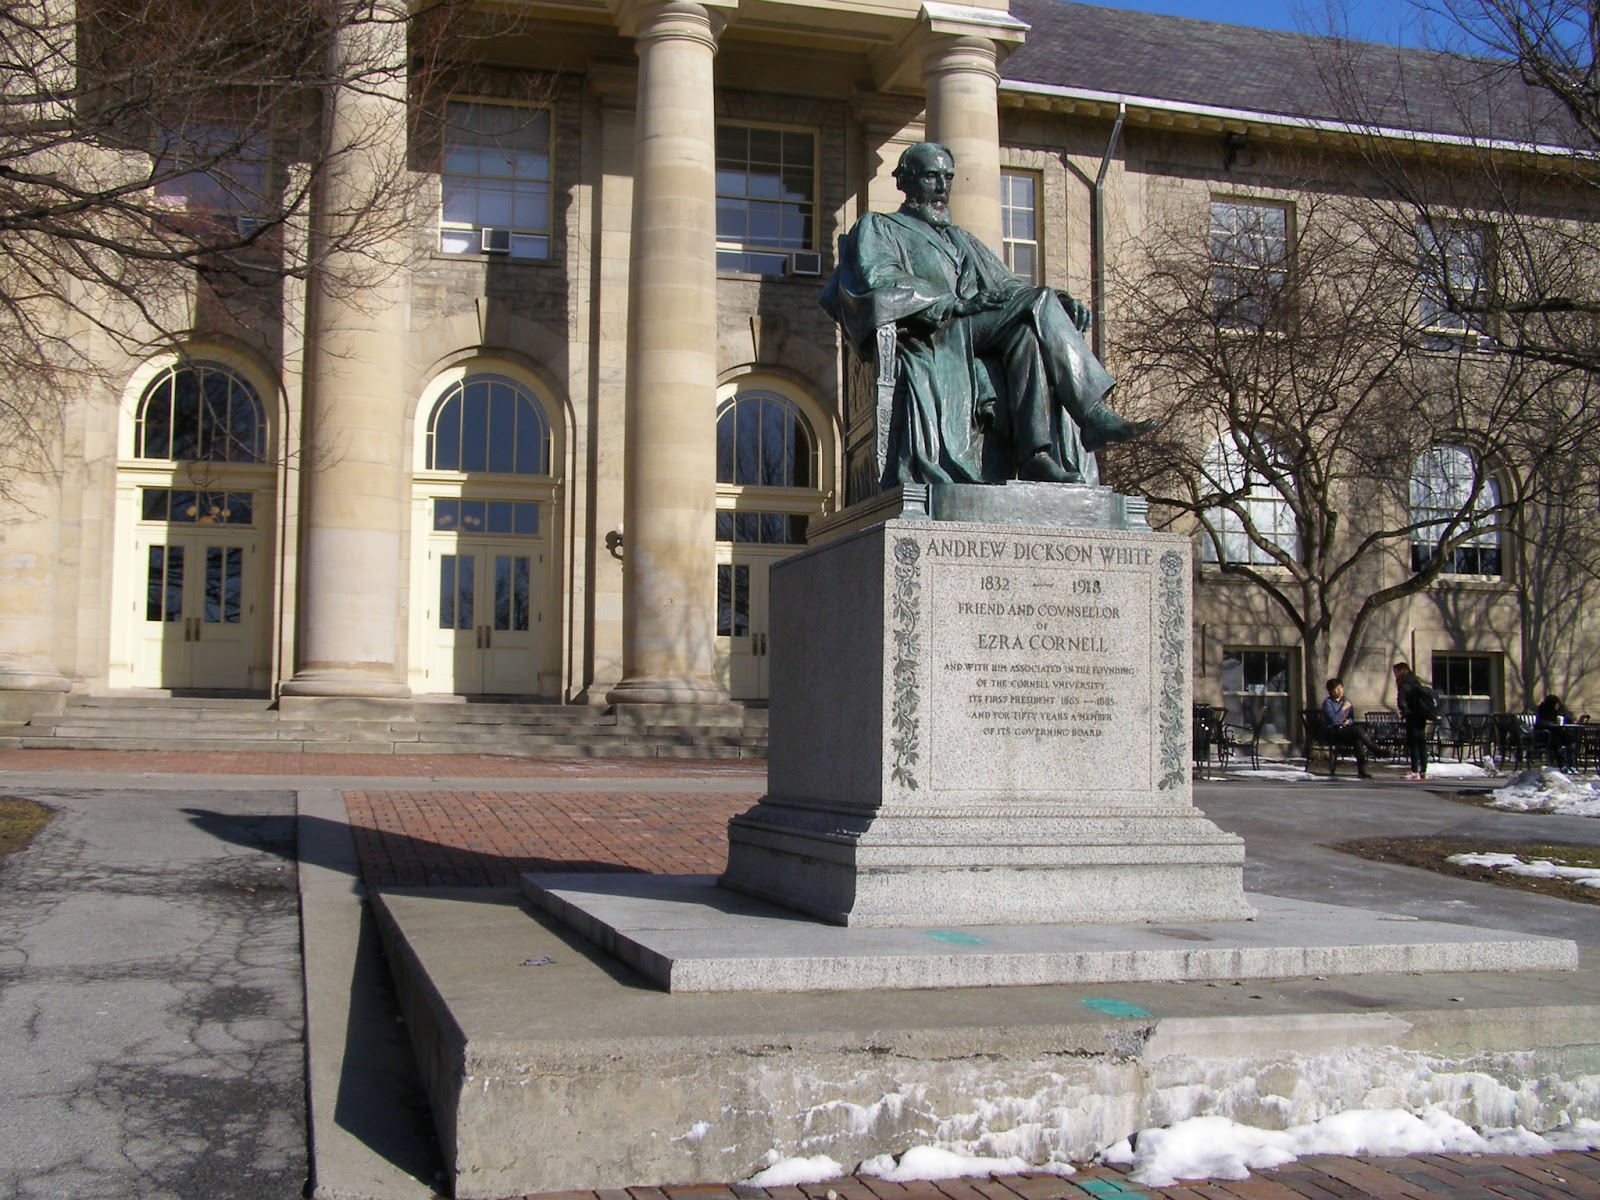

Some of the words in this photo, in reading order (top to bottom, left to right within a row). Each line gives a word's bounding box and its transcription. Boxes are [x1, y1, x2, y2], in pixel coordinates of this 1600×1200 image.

[926, 538, 1006, 559] ANDREW
[1013, 542, 1093, 563] DICKSON
[1100, 547, 1154, 566] WHITE
[980, 576, 1010, 591] 1832
[1072, 580, 1102, 595] 1918
[958, 602, 1005, 616] FRIEND
[1008, 604, 1035, 617] AND
[1036, 622, 1049, 631] OF
[978, 634, 1024, 650] EZRA
[1029, 635, 1108, 653] CORNELL
[944, 663, 963, 671] AND
[964, 663, 989, 672] WITH
[1010, 664, 1062, 673] ASSOCIATED
[1065, 665, 1074, 674] IN
[1075, 665, 1091, 674] THE
[990, 680, 1007, 688] THE
[1010, 680, 1050, 689] CORNELL
[969, 695, 982, 703] ITS
[984, 695, 1009, 704] FIRST
[1010, 695, 1055, 705] PRESIDENT
[971, 711, 991, 719] AND
[993, 711, 1011, 720] FOR
[1013, 711, 1037, 720] FIFTY
[1040, 712, 1069, 721] YEARS
[1071, 713, 1077, 721] A
[1078, 712, 1113, 721] MEMBER
[982, 727, 995, 735] OF
[997, 726, 1011, 736] ITS
[1014, 727, 1069, 737] GOVERNING
[1071, 728, 1102, 737] BOARD
